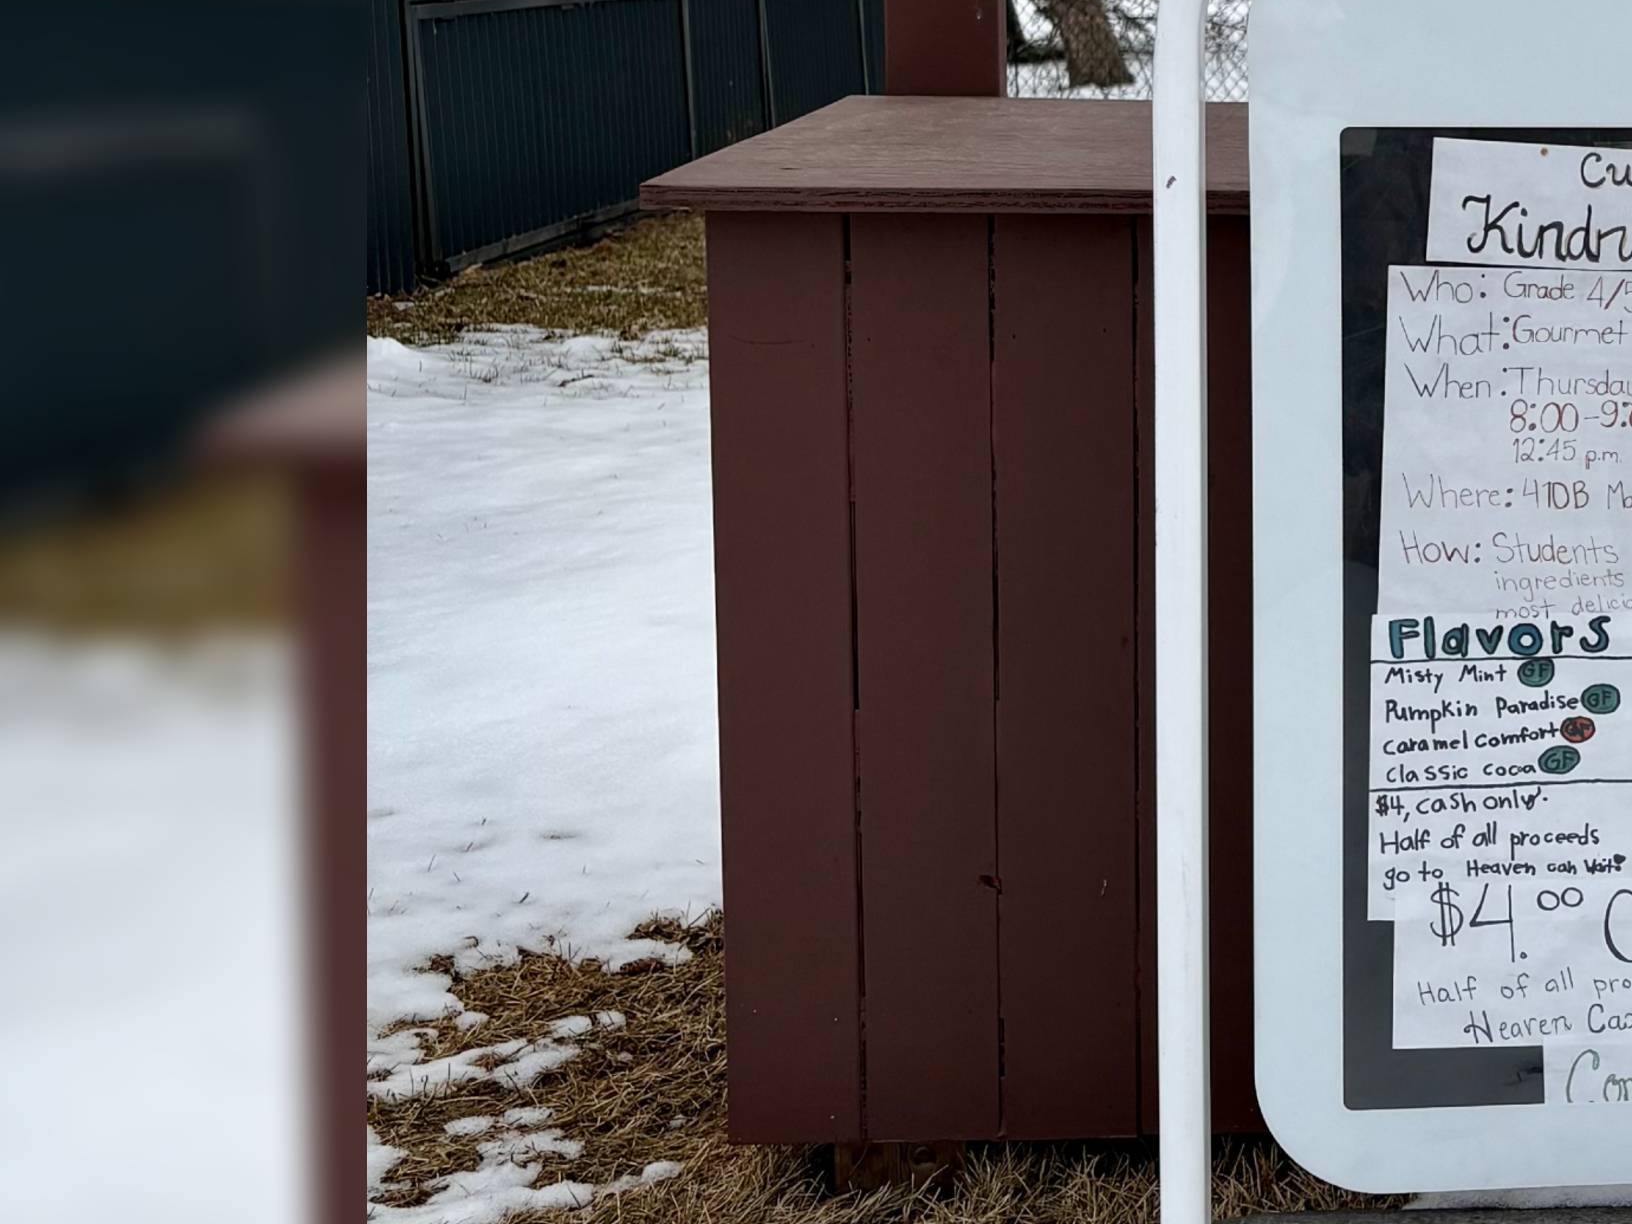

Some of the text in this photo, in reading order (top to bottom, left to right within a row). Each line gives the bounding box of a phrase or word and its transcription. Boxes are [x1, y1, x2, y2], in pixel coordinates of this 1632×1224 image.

[1400, 270, 1488, 303] Who:
[1503, 271, 1575, 301] Grade
[1398, 311, 1511, 356] What:
[1512, 314, 1629, 345] Gourmet
[1403, 362, 1507, 399] When:
[1512, 436, 1577, 463] 12:45
[1402, 472, 1513, 508] Where:
[1522, 477, 1590, 510] 410B
[1399, 530, 1482, 564] How:
[1492, 531, 1619, 566] Students
[1494, 568, 1625, 602] ingredients
[1495, 599, 1556, 620] most
[1388, 615, 1611, 660] Flavors
[1385, 661, 1550, 693] Misty Mint GF
[1386, 690, 1613, 734] Pumpkin Paradise GF
[1544, 750, 1576, 772] GF
[1416, 792, 1477, 813] cash
[1379, 821, 1600, 861] Half of all proceeds
[1383, 867, 1411, 891] go
[1418, 861, 1444, 881] to
[1466, 859, 1537, 877] Heaven
[1547, 861, 1577, 875] can
[1417, 976, 1477, 1006] Half
[1500, 972, 1530, 999] of
[1545, 966, 1574, 993] all
[1463, 1010, 1572, 1044] Heaven
